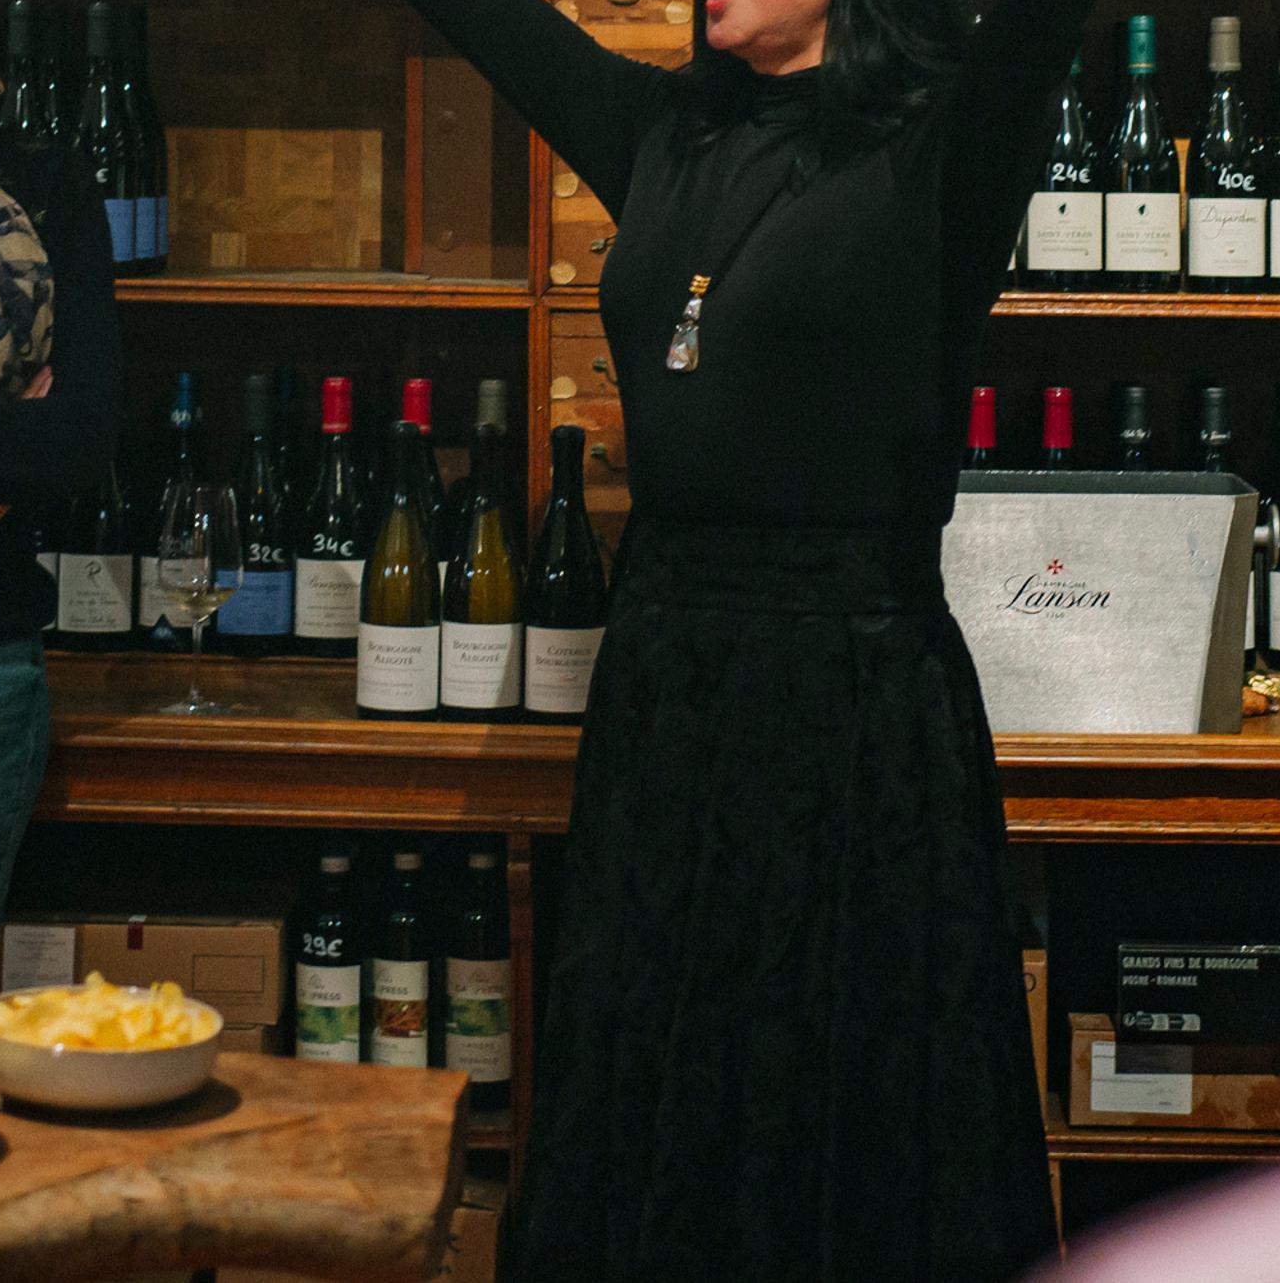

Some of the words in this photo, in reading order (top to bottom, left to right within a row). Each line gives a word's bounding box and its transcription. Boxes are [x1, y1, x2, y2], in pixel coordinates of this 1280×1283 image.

[1052, 162, 1092, 184] 24€
[1218, 168, 1257, 192] 40€
[313, 533, 355, 558] 34€
[996, 573, 1112, 615] Lanson
[1122, 956, 1161, 969] GRANDS
[1188, 957, 1202, 969] DE
[1204, 957, 1260, 970] BOURGOGNE
